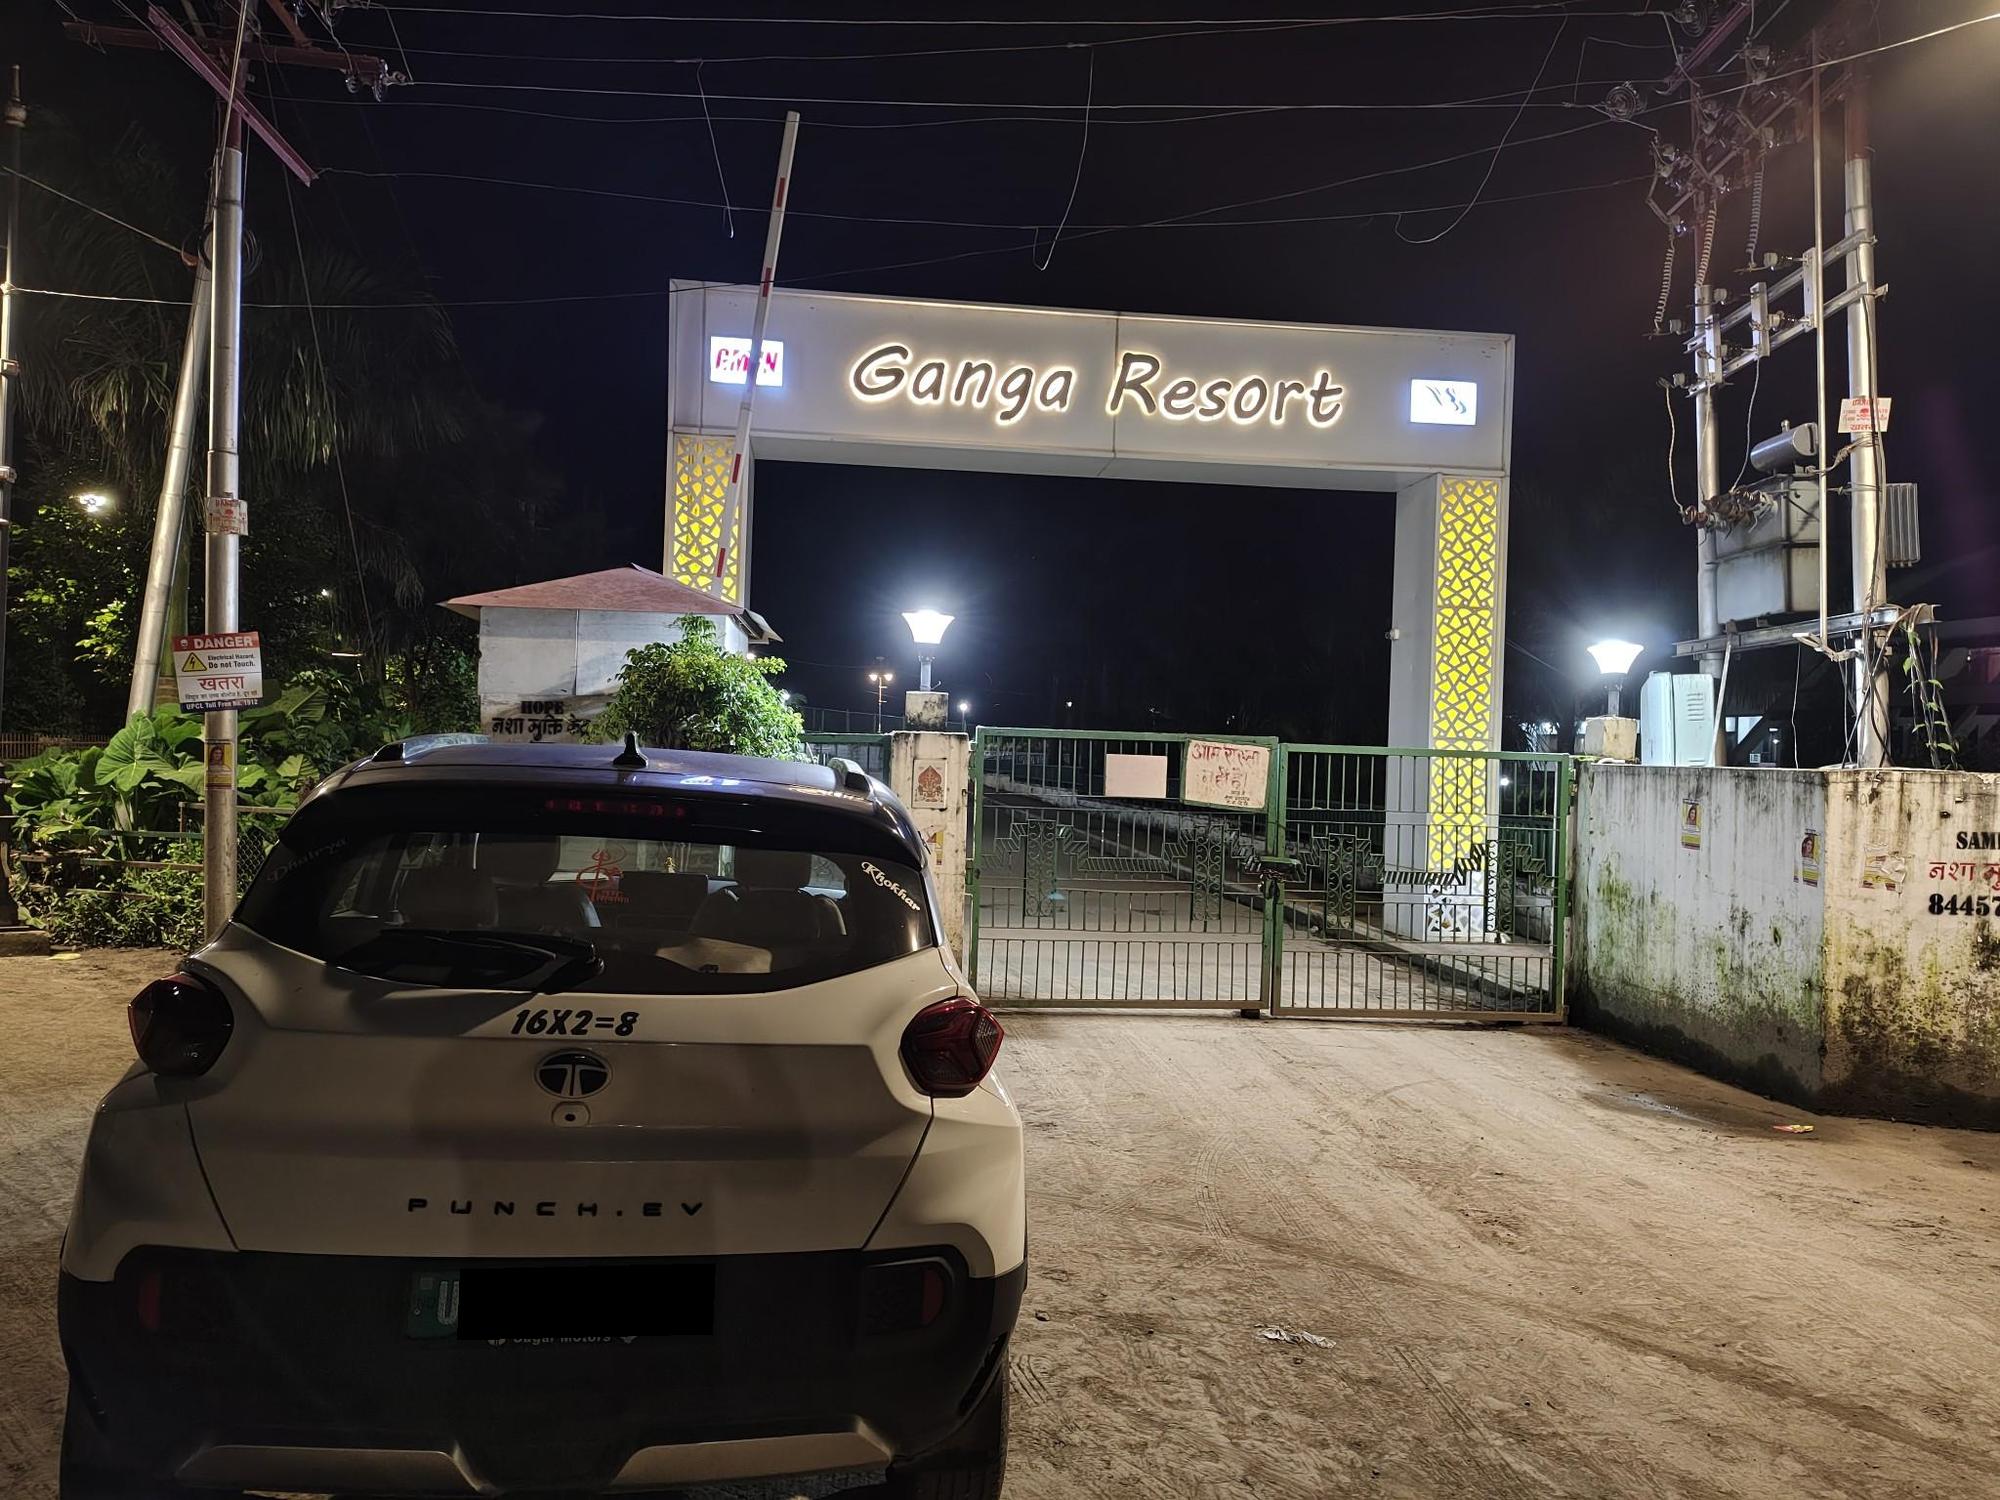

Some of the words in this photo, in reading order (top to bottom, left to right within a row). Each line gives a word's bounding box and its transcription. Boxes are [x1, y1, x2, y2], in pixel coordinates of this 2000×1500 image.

[852, 344, 1074, 421] Ganga
[1109, 351, 1344, 424] Resort
[193, 636, 253, 649] DANGER
[220, 661, 232, 669] not
[234, 660, 256, 668] Touch.
[197, 677, 245, 690] खतरा
[520, 700, 564, 714] HOPE
[492, 717, 524, 734] नशा
[527, 714, 563, 741] मुक्ति
[1956, 831, 2000, 850] SAM
[1928, 861, 1977, 880] नशा
[861, 861, 921, 911] Khokhar
[511, 1009, 640, 1037] 16X2=8
